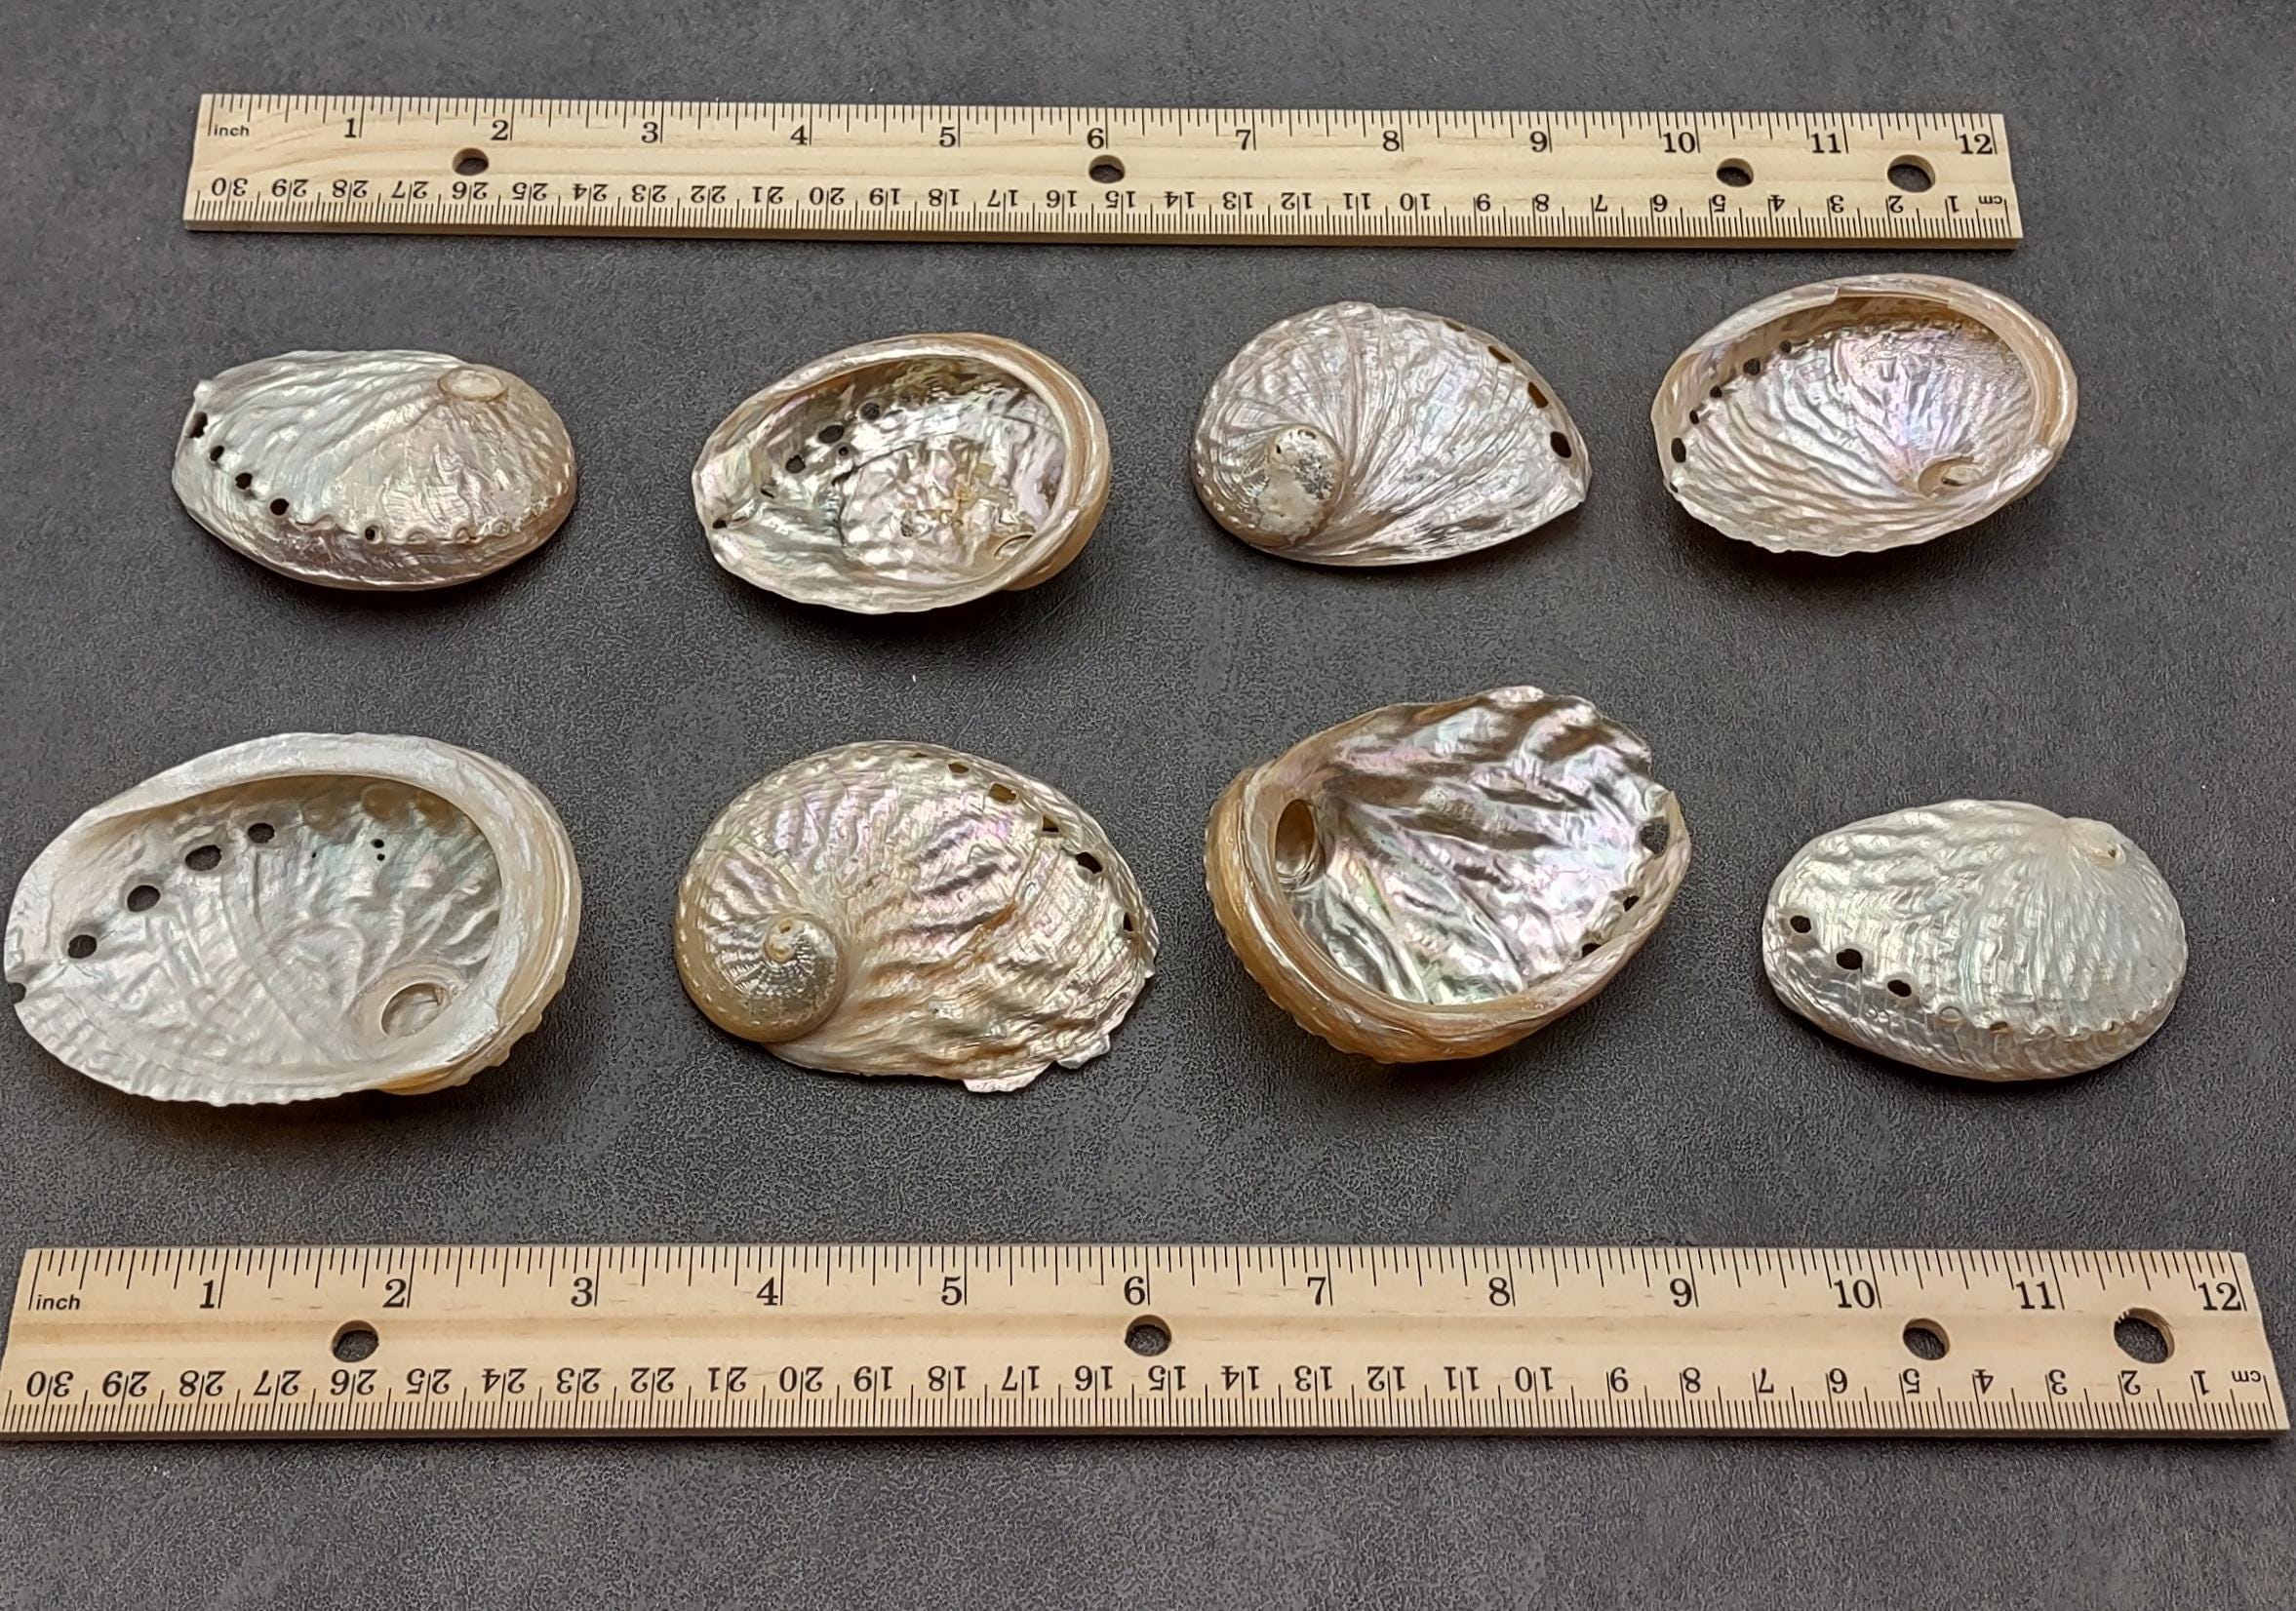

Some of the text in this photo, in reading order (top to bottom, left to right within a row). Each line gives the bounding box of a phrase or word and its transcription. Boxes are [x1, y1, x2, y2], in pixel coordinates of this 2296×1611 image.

[214, 118, 1994, 154] inch 1 2 3 4 5 6 7 8 9 10 11 12
[212, 177, 2002, 214] cm 1 2 3 4 5 6 7 8 9 10 11 12 13 14 15 16 17 18 19 20 21 22 23 24 25 26 27 28 29 30
[35, 1277, 2241, 1312] inch 1 2 3 4 5 6 7 8 9 10 11 12
[26, 1365, 2261, 1397] cm 1 2 3 4 5 6 7 8 9 10 11 12 13 14 15 16 17 18 19 20 21 22 23 24 25 26 27 28 29 30
